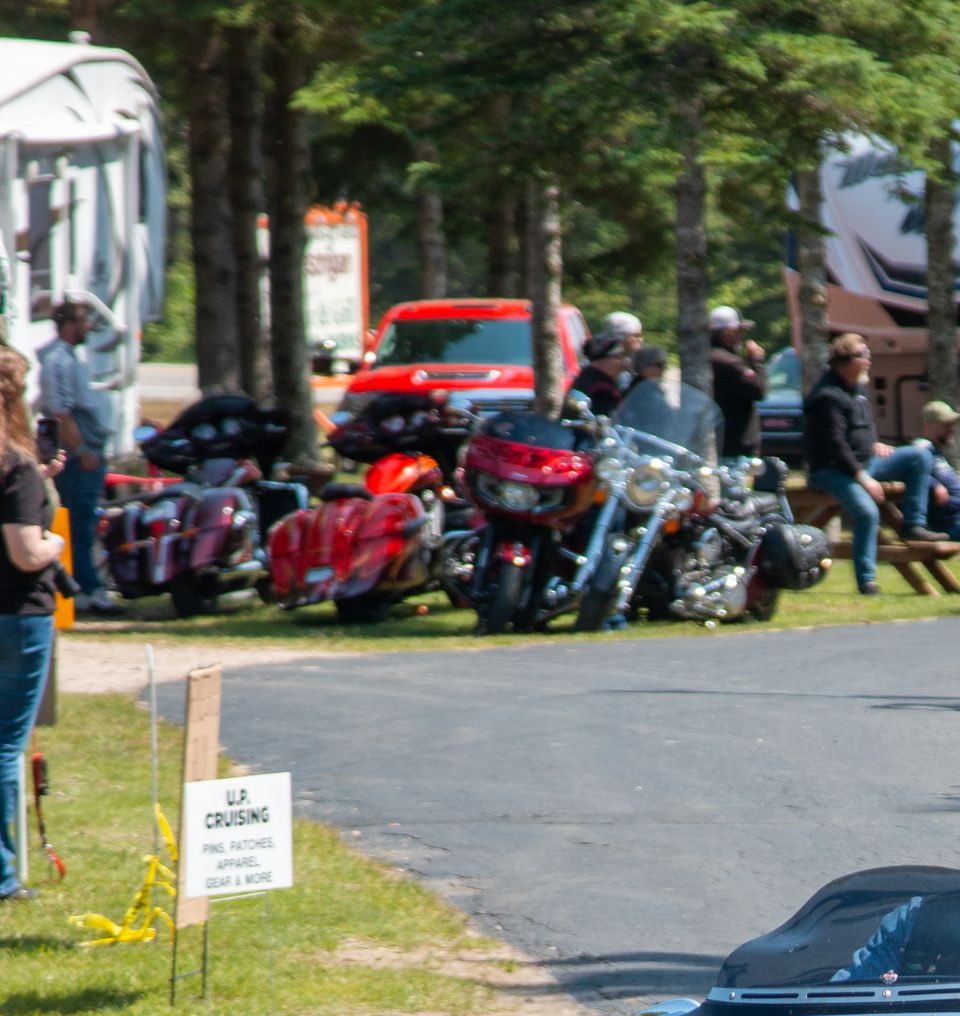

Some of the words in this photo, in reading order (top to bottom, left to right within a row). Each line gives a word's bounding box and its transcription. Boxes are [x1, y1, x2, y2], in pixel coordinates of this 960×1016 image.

[226, 788, 251, 806] U.P.
[205, 806, 270, 829] CRUISING
[205, 876, 232, 889] GEAR
[235, 874, 241, 886] &
[245, 871, 273, 884] MORE
